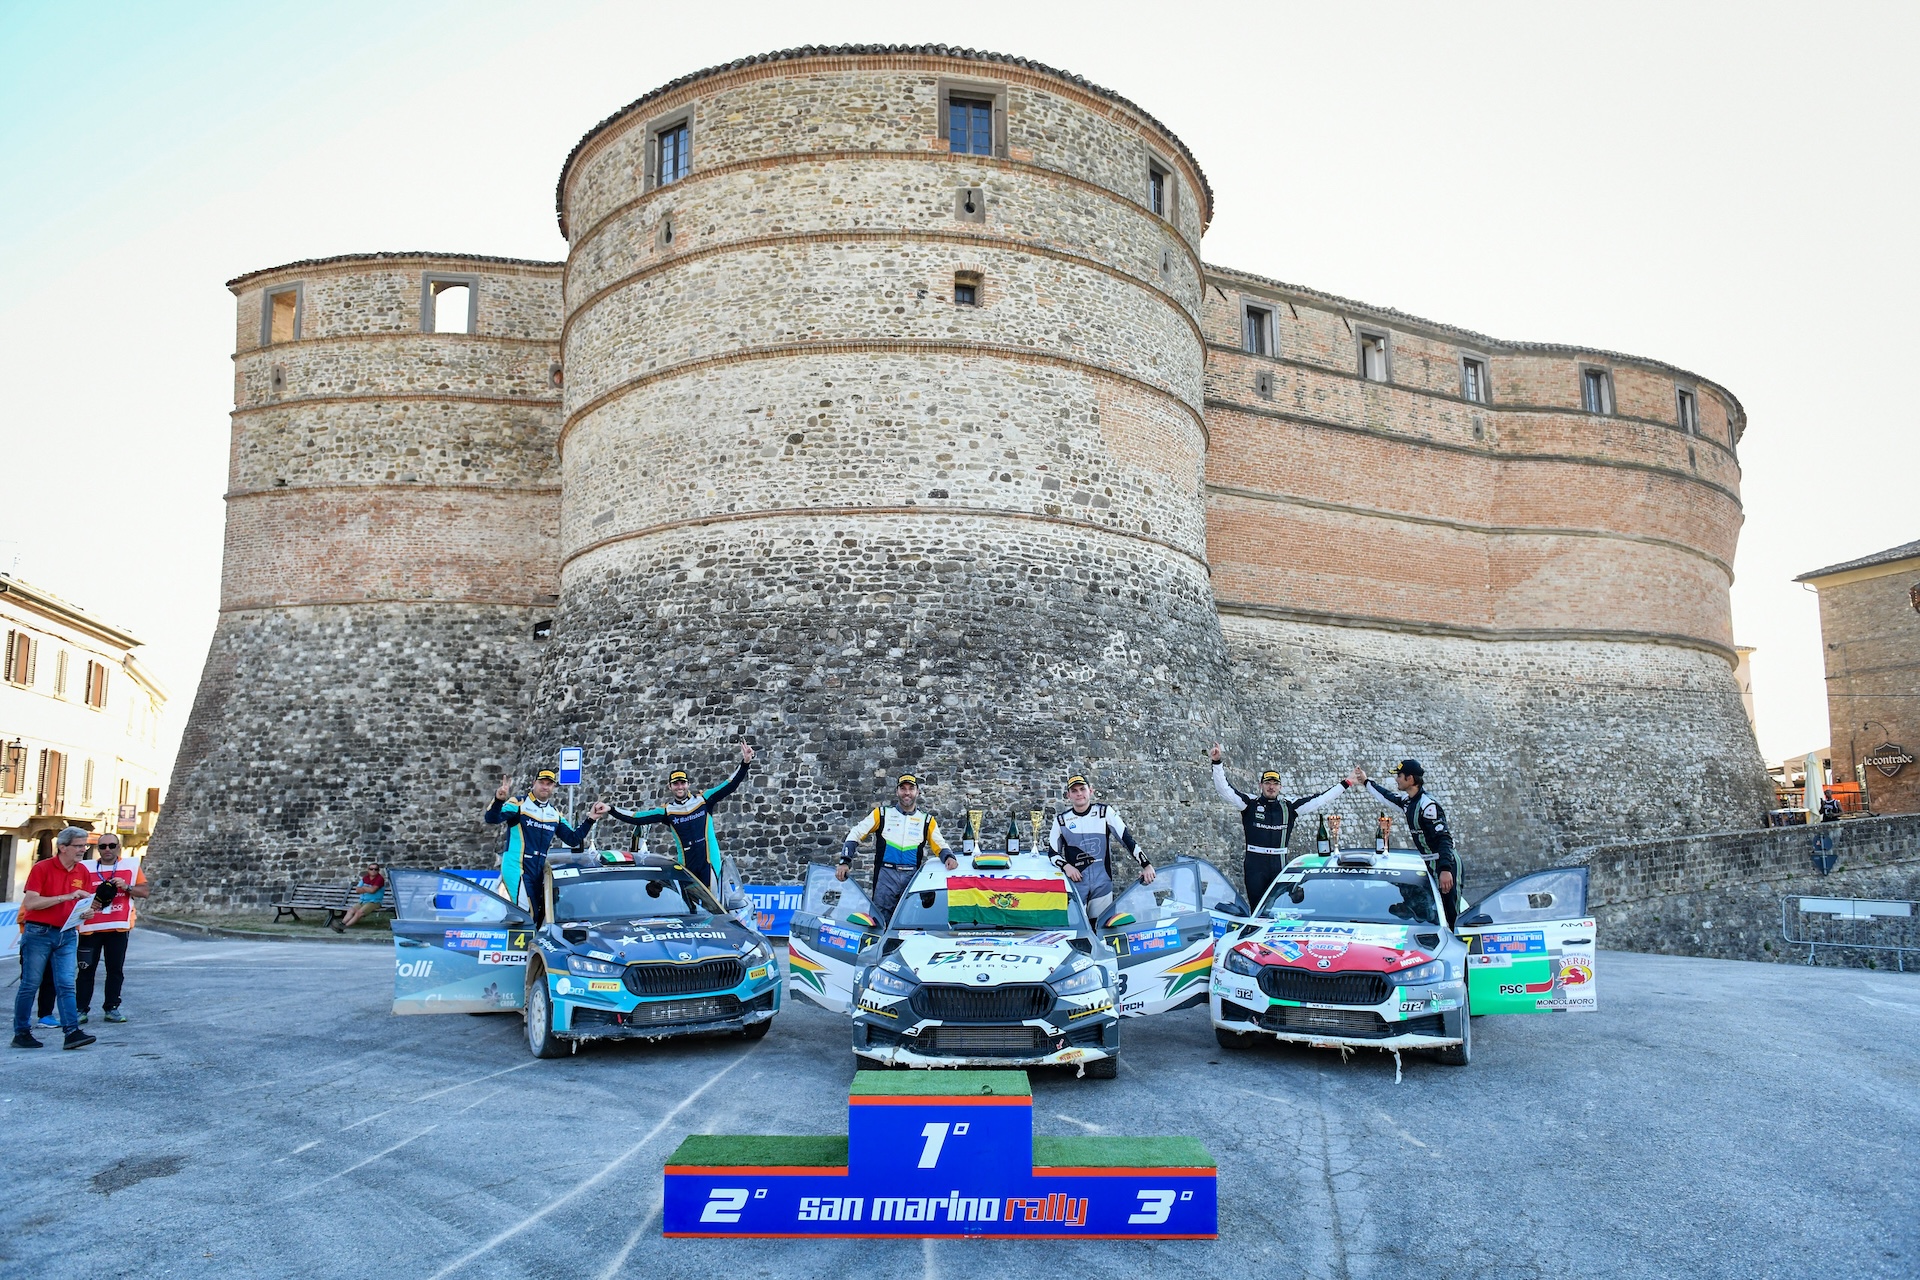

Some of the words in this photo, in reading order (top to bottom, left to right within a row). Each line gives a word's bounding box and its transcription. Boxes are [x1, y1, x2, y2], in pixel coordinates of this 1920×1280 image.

[1321, 868, 1401, 876] MUNARETTO
[1267, 926, 1355, 934] PERIN
[514, 933, 526, 949] 4
[641, 931, 727, 943] Battistolli
[865, 937, 873, 947] 1
[1113, 937, 1121, 954] 1
[1462, 936, 1474, 953] 7
[1500, 941, 1526, 952] rally
[1400, 956, 1424, 967] MOTUL
[1559, 957, 1593, 970] DERBY
[591, 982, 618, 990] PIRELLI
[1499, 985, 1524, 994] PSC
[1400, 1001, 1425, 1012] GT2i
[797, 1195, 863, 1222] san
[870, 1189, 1001, 1222] marino
[1003, 1192, 1088, 1228] rally
